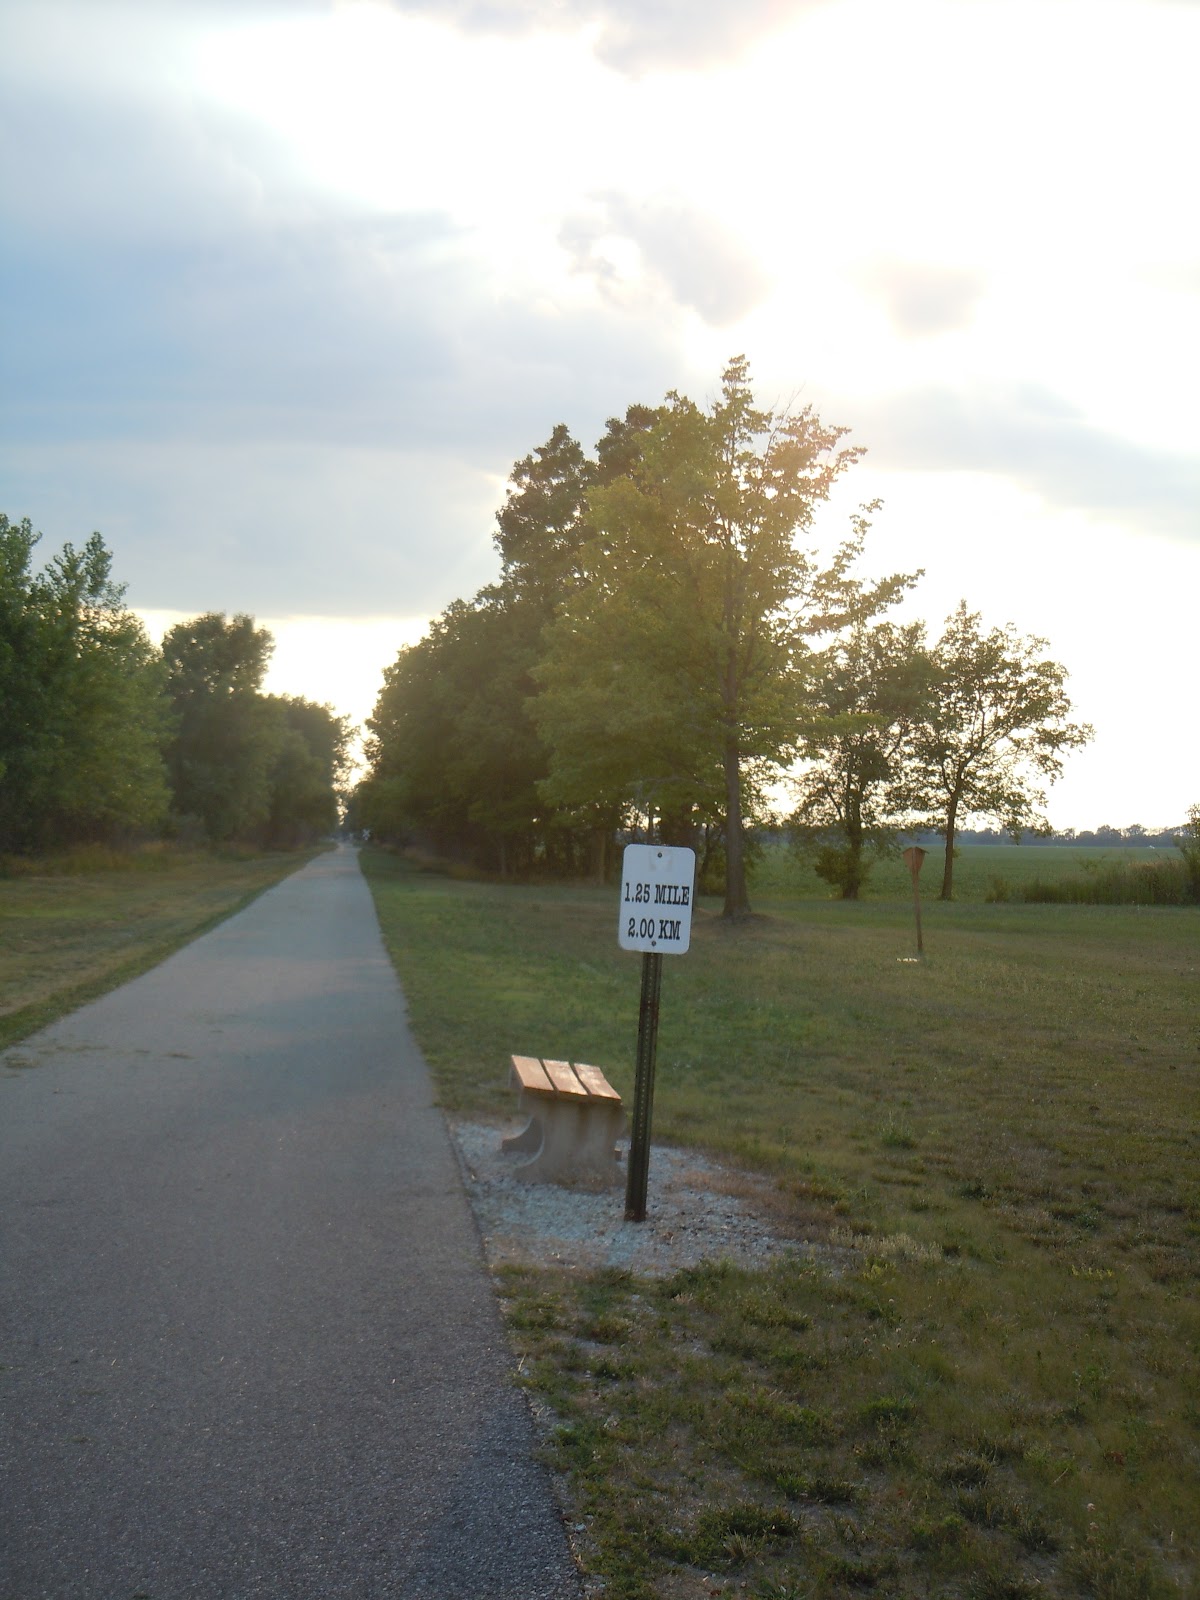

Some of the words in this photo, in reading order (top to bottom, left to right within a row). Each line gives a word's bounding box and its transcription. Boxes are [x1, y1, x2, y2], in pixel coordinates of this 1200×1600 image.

[625, 882, 650, 903] 1.25
[654, 884, 689, 906] MILE
[628, 917, 655, 939] 2.00
[658, 919, 681, 941] KM
